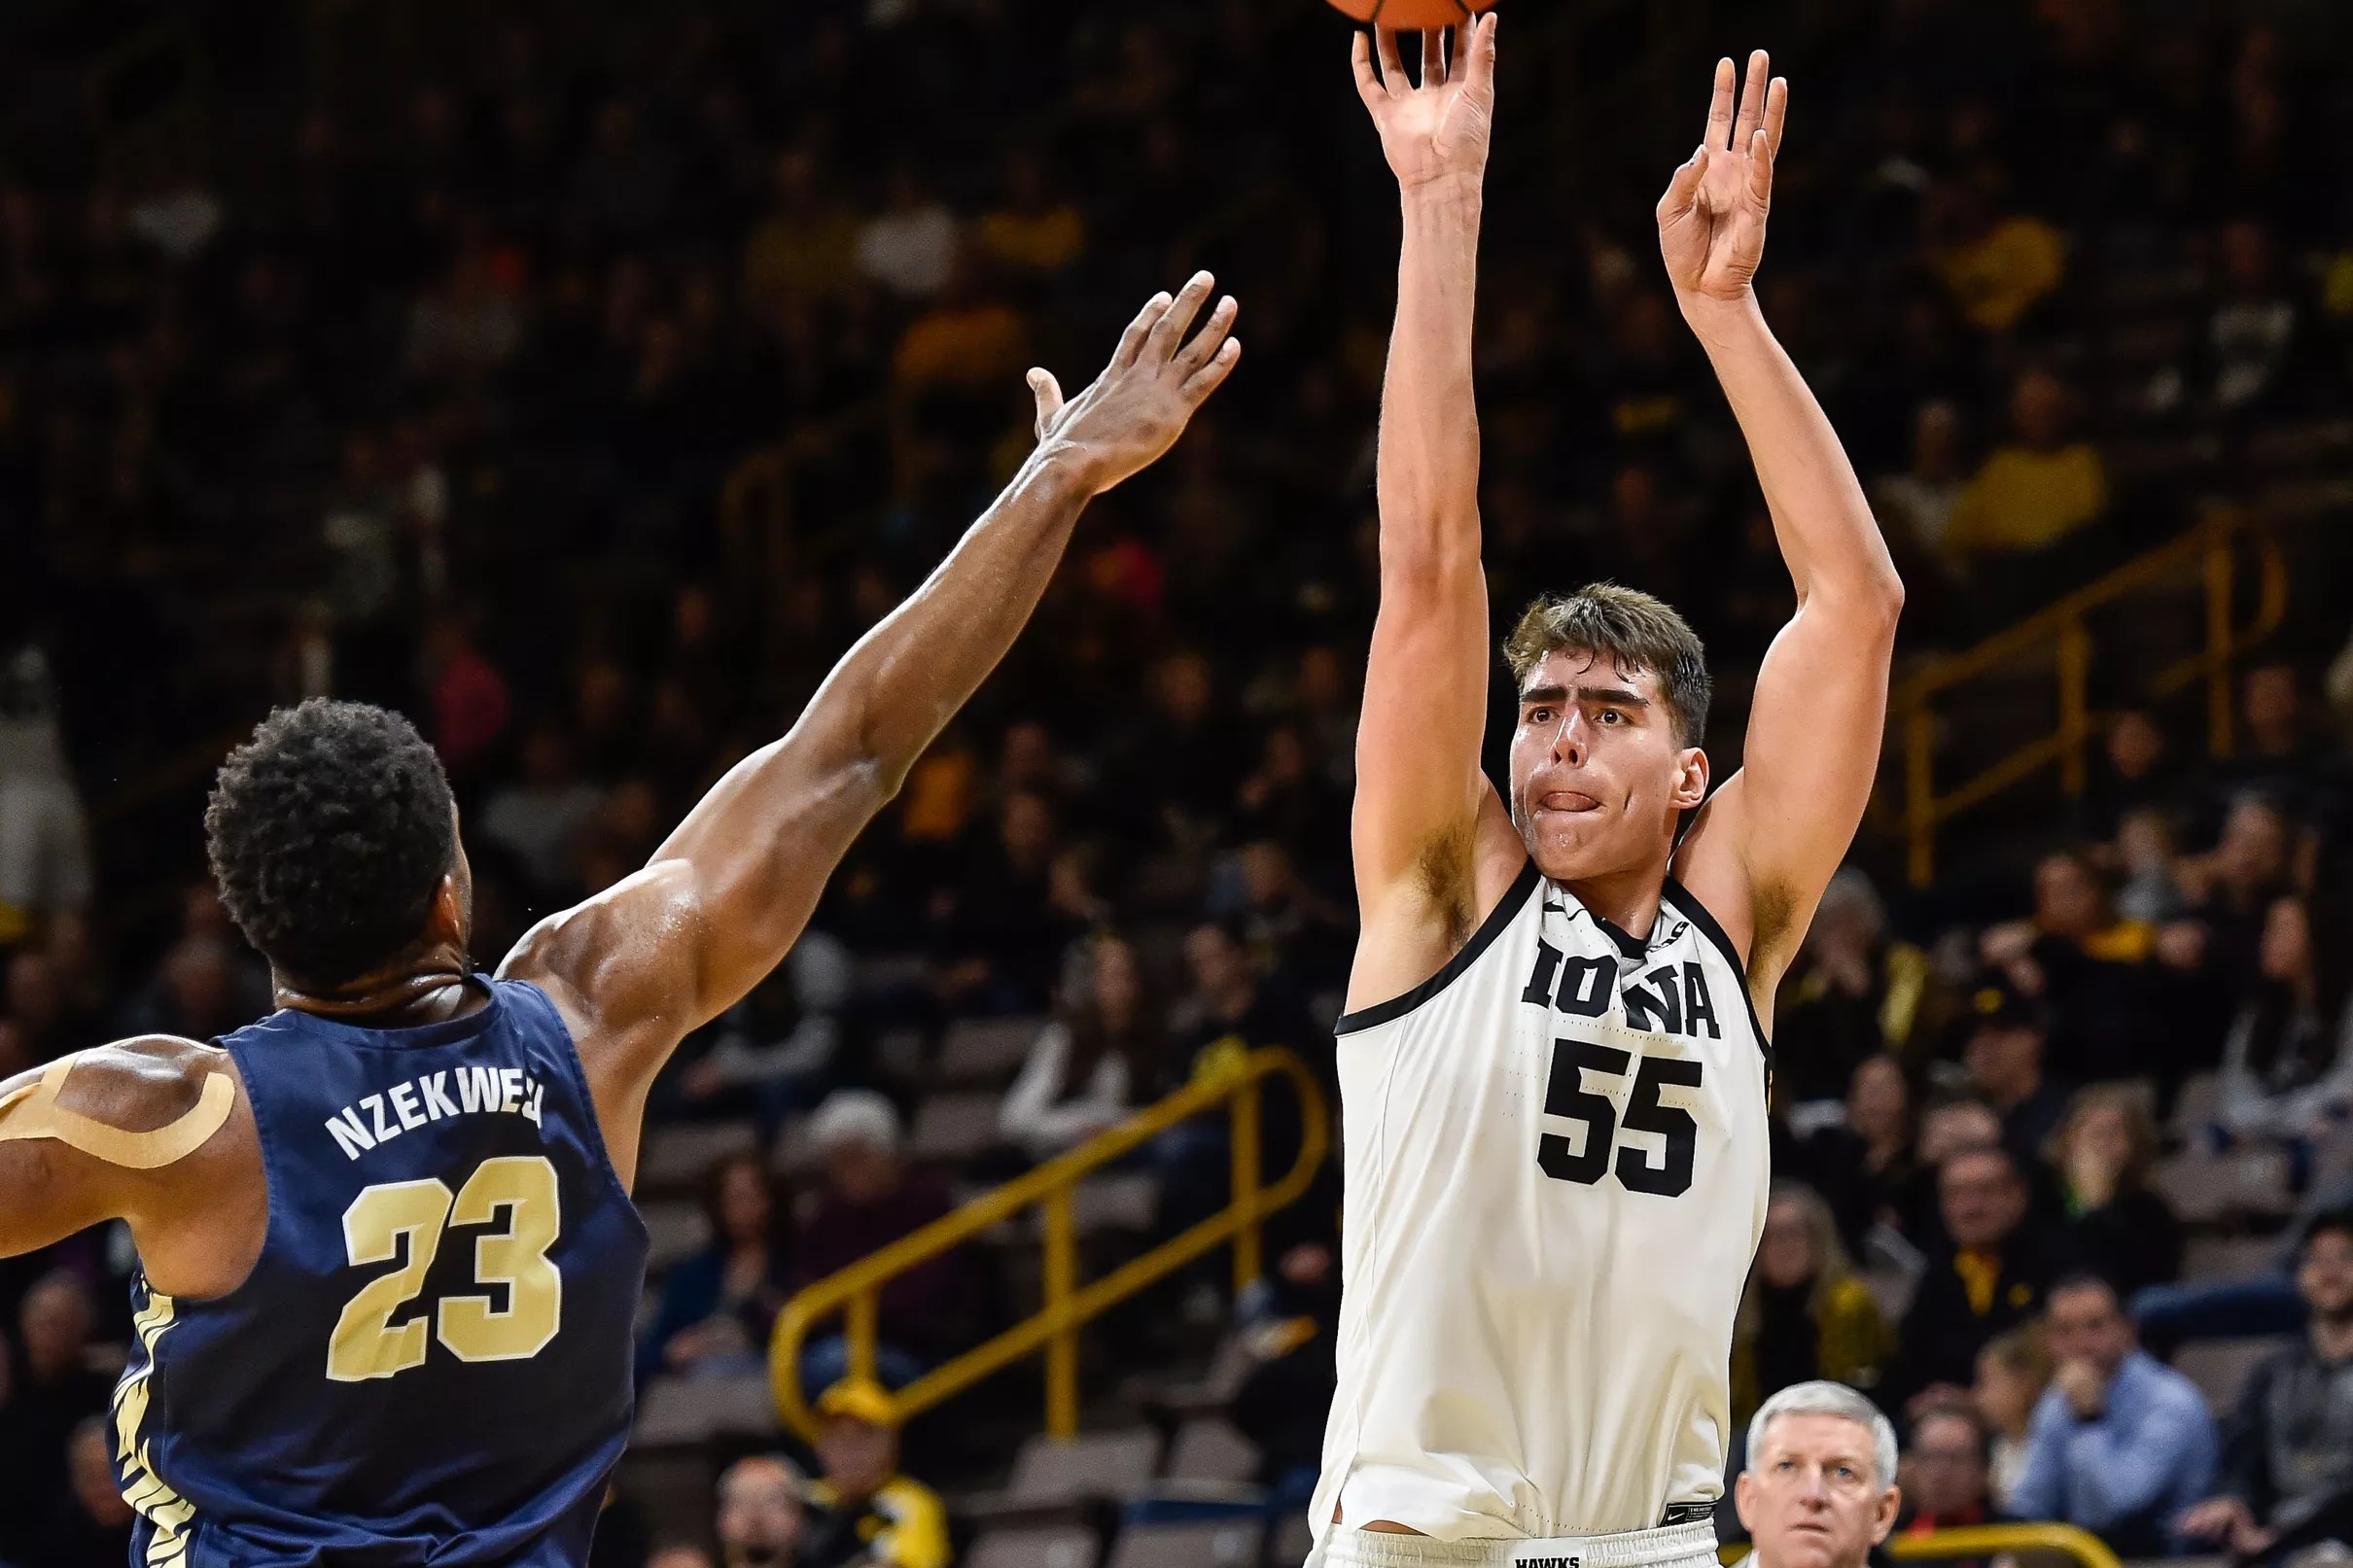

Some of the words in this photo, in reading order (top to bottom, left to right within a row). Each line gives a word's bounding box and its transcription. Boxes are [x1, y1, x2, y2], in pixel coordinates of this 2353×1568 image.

[1522, 936, 1721, 1039] IOWA
[1537, 1037, 1703, 1198] 55
[326, 1156, 562, 1382] 23
[1515, 1556, 1580, 1568] HAWKS
